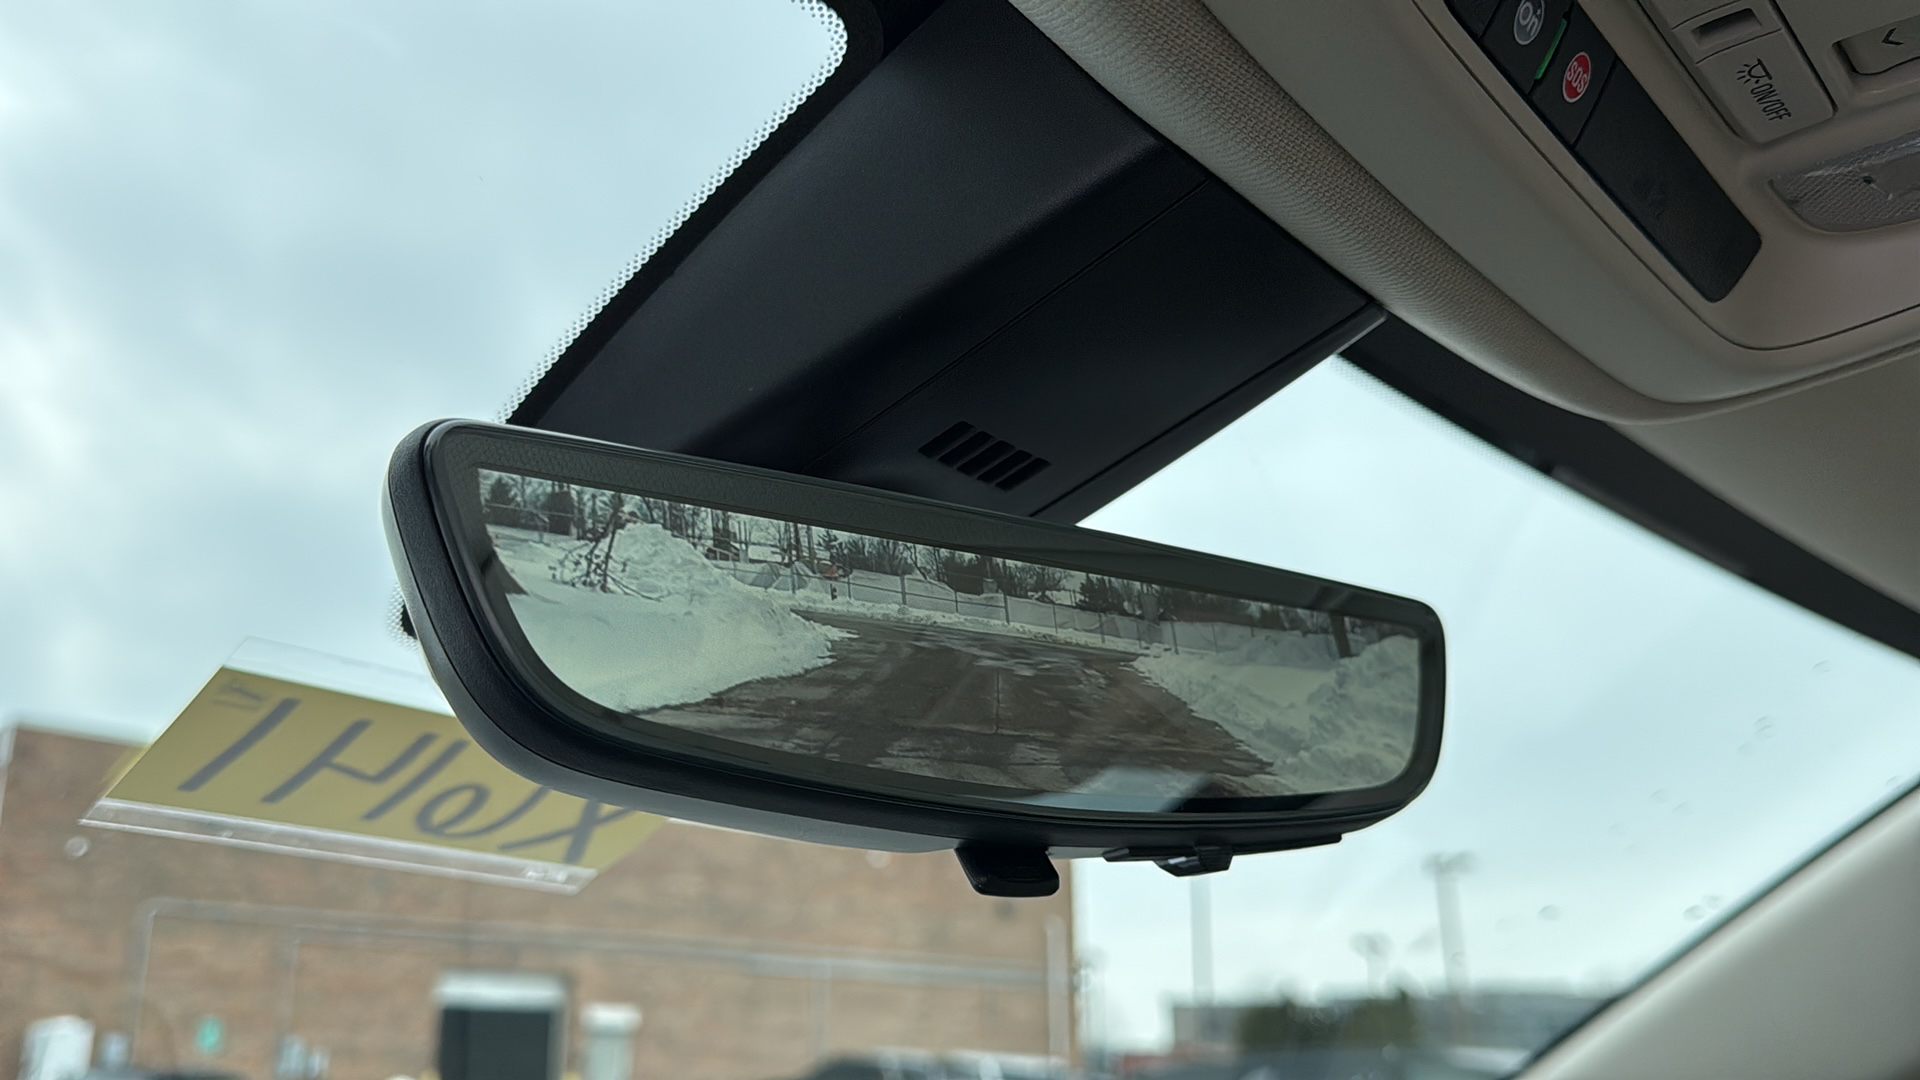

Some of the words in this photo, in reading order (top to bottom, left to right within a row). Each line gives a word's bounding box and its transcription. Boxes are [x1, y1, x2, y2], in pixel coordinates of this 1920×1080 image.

[1518, 5, 1540, 36] On
[1567, 61, 1588, 94] SOS
[1751, 84, 1791, 121] ON/OFF
